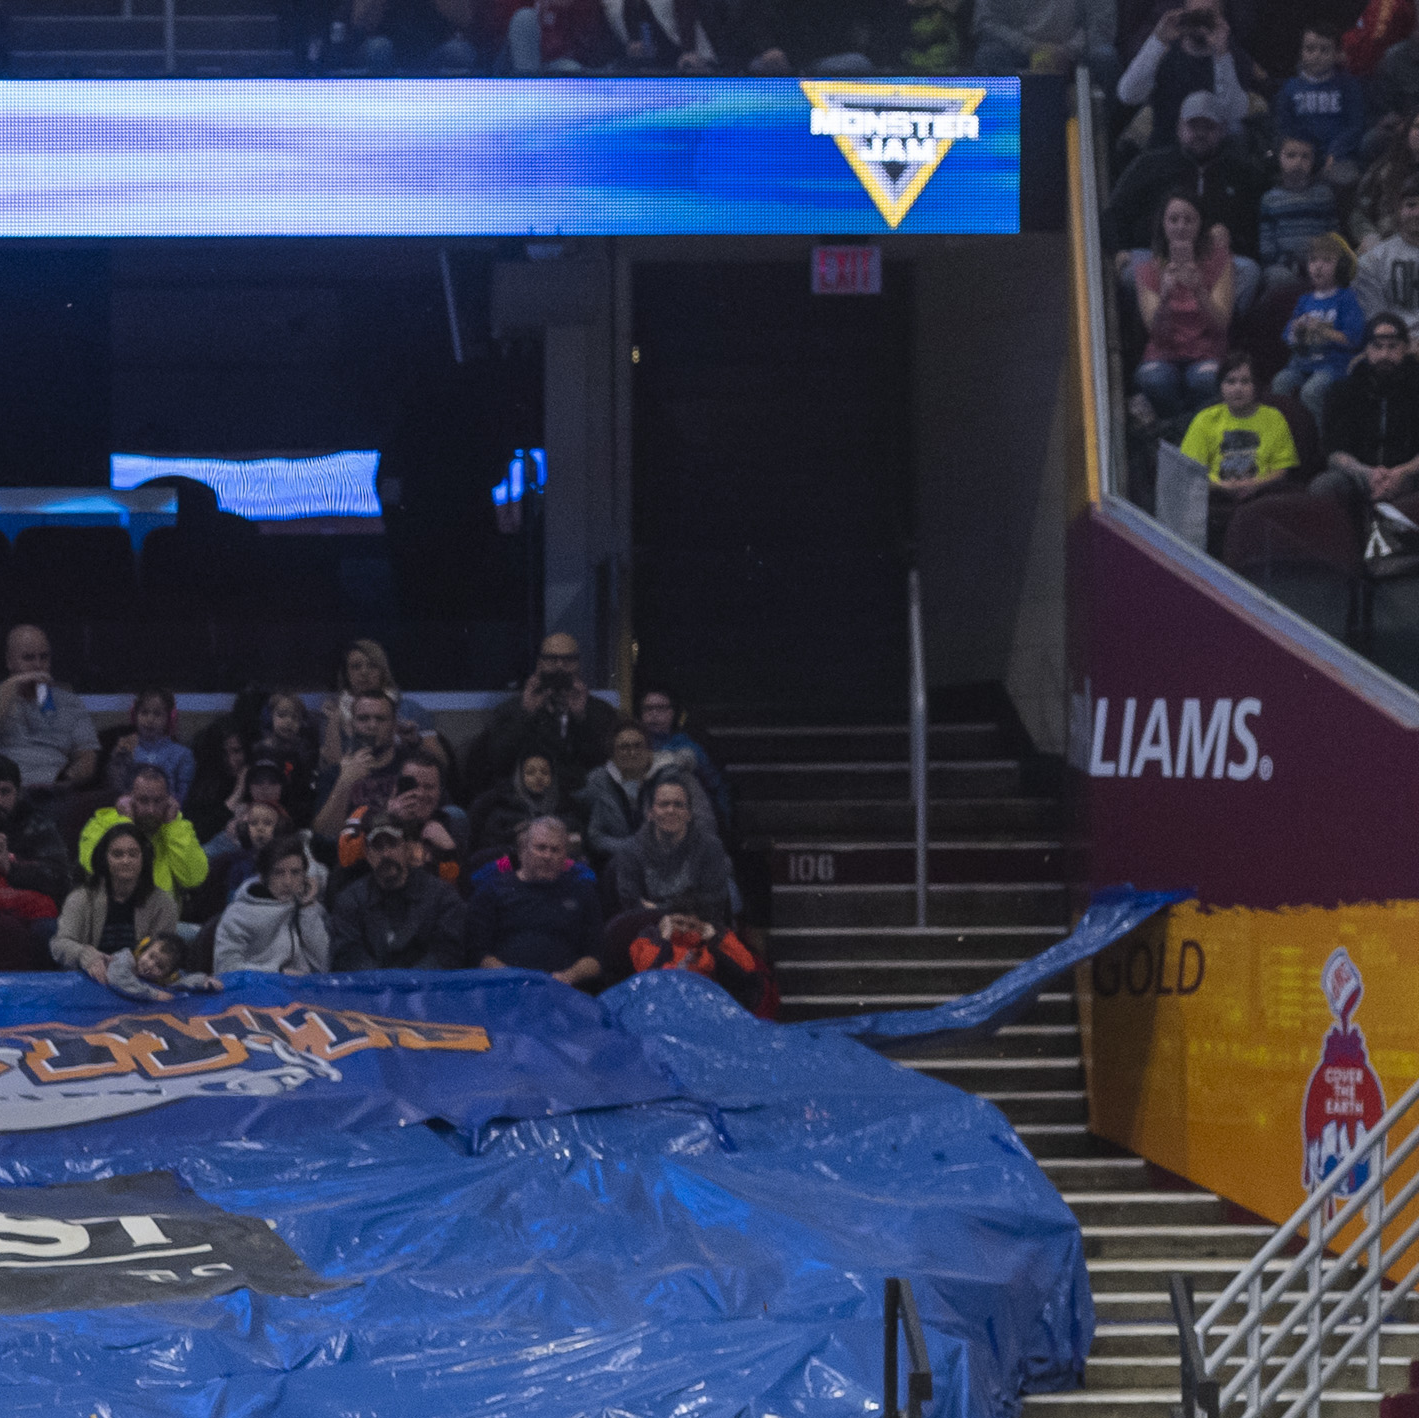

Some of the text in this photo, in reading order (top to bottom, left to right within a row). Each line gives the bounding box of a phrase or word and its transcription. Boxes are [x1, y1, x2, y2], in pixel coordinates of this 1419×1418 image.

[810, 107, 980, 140] MONSTER
[859, 136, 938, 163] JAM
[818, 248, 872, 292] EXIT
[1324, 1066, 1365, 1085] COVER
[1334, 1085, 1356, 1099] THE
[1324, 1100, 1365, 1116] EARTH
